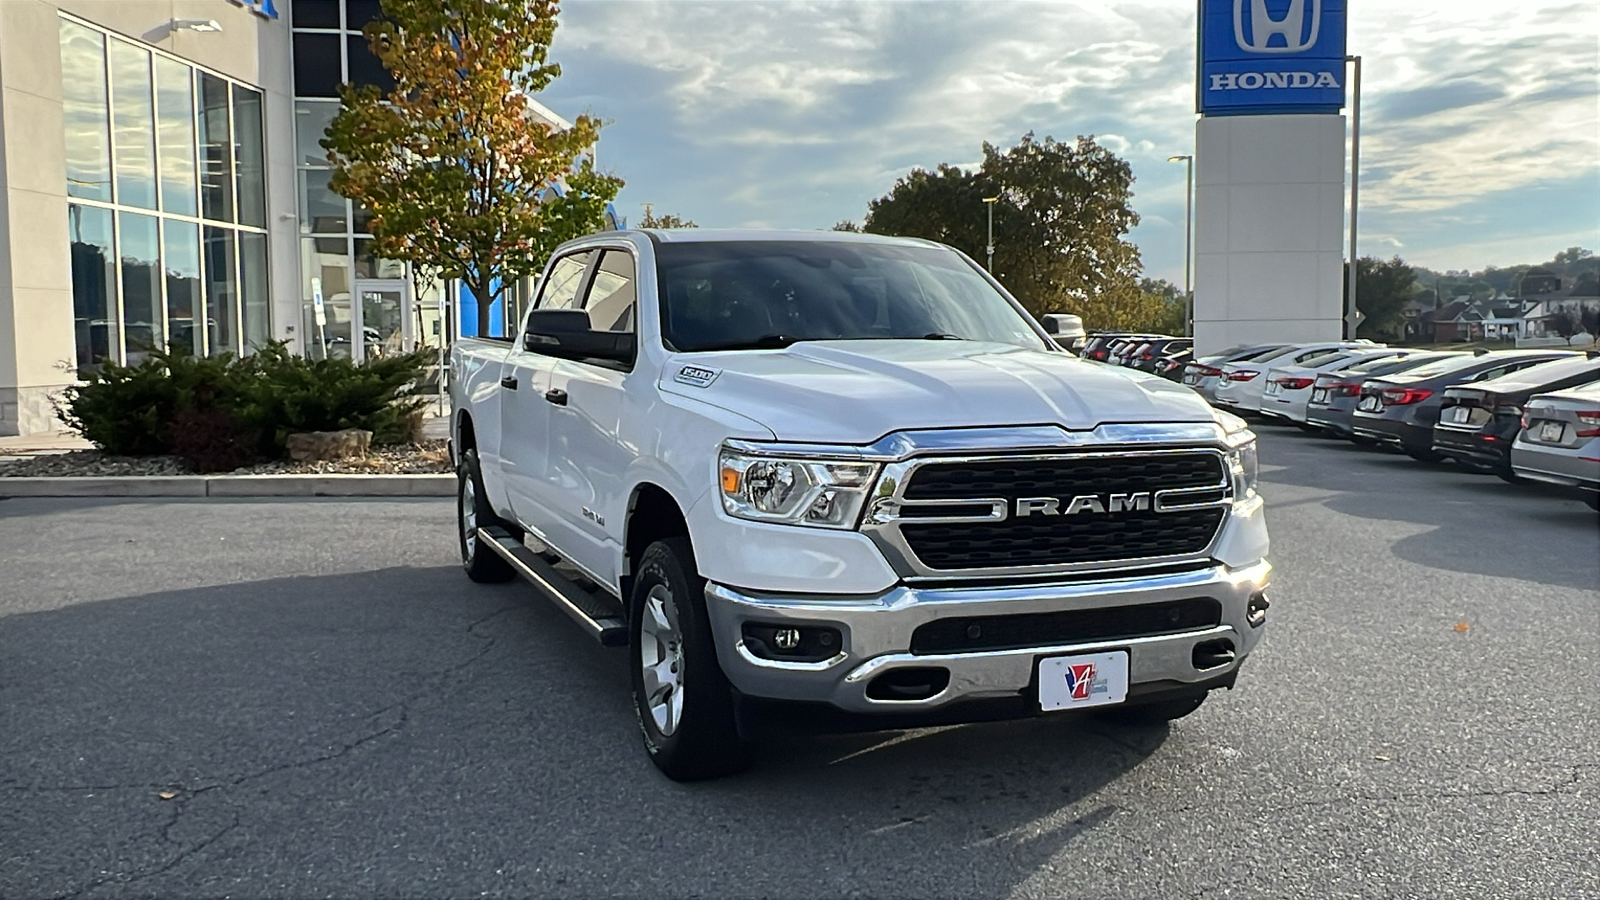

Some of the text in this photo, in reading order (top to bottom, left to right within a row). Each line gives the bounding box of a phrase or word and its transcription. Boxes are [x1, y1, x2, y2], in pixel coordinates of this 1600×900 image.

[1209, 71, 1341, 91] HONDA
[683, 367, 713, 380] 1500
[1016, 491, 1150, 516] RAM
